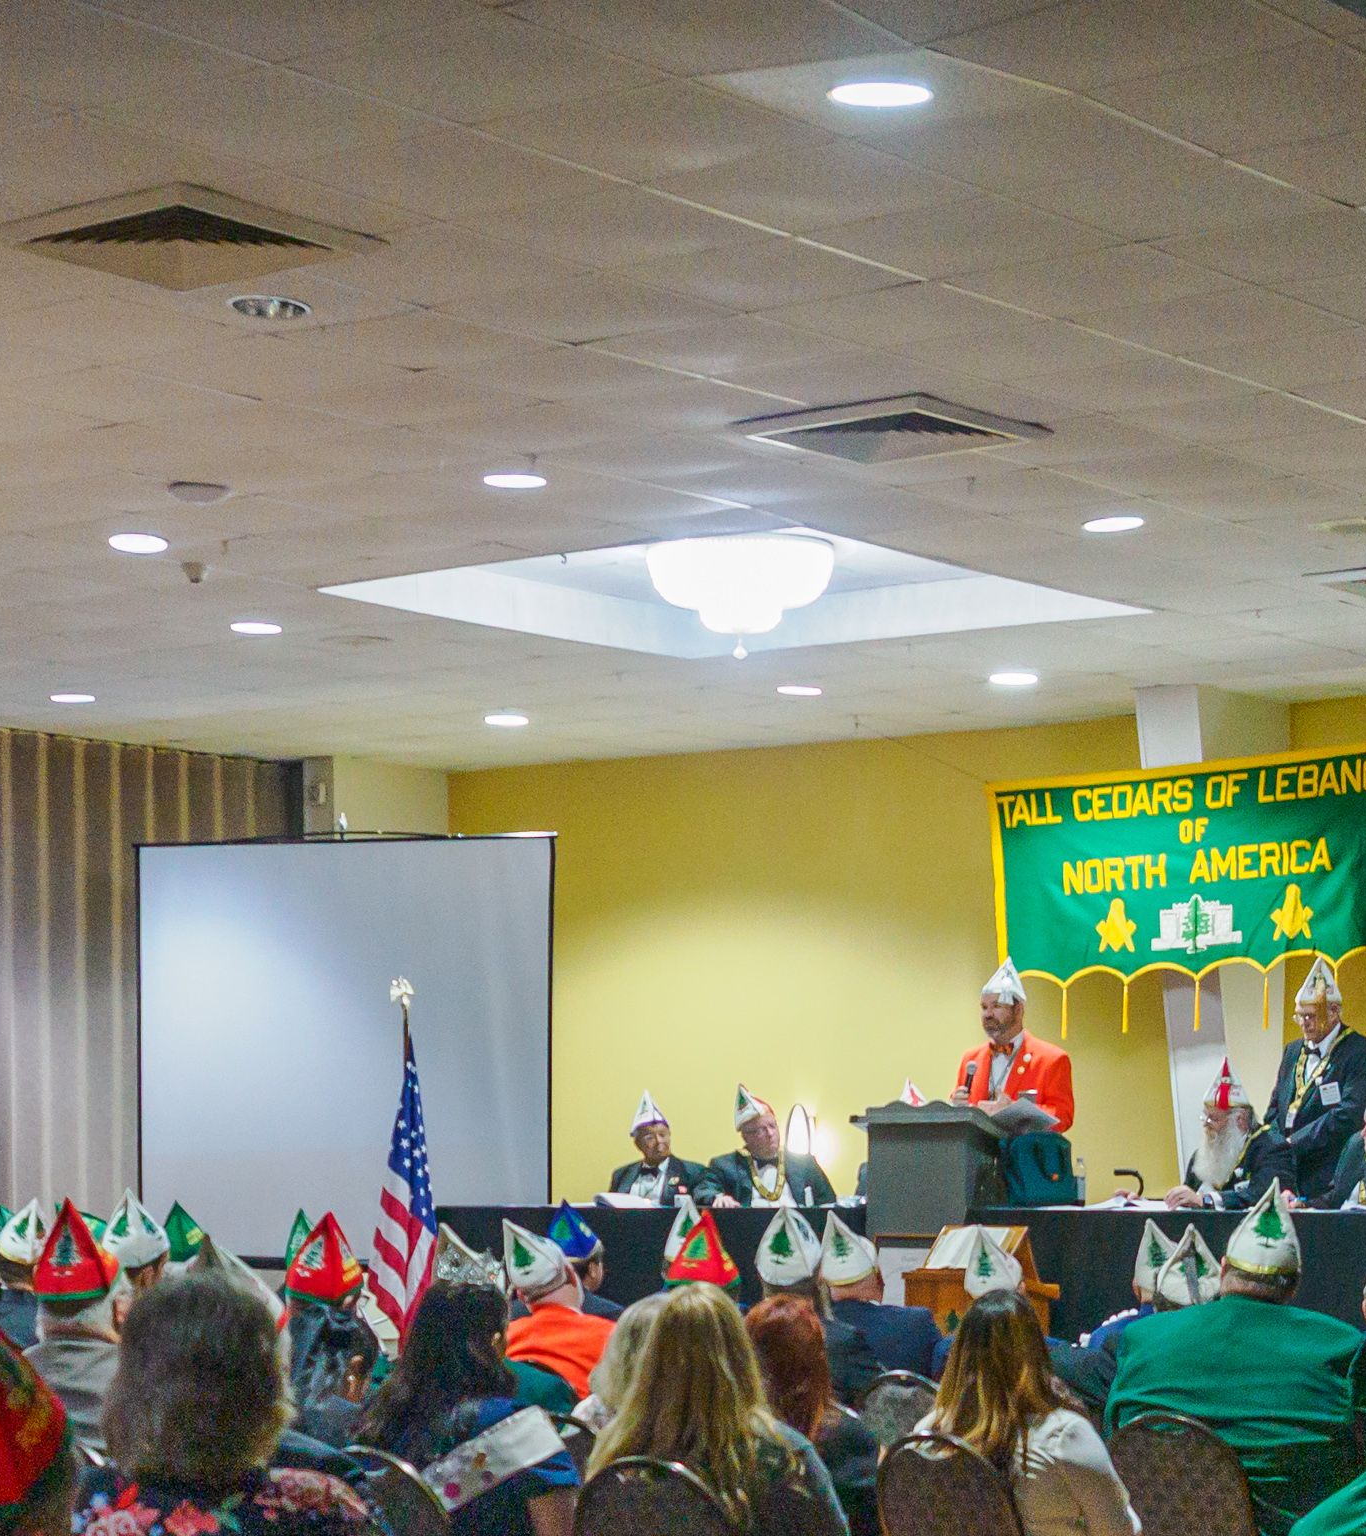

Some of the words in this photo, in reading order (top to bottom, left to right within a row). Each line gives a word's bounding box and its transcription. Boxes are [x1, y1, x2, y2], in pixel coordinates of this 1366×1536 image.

[997, 792, 1063, 828] TALL
[1072, 778, 1194, 821] CEDARS
[1205, 772, 1249, 809] OF
[1178, 818, 1209, 843] OF
[1062, 853, 1167, 896] NORTH
[1189, 837, 1333, 884] AMERICA
